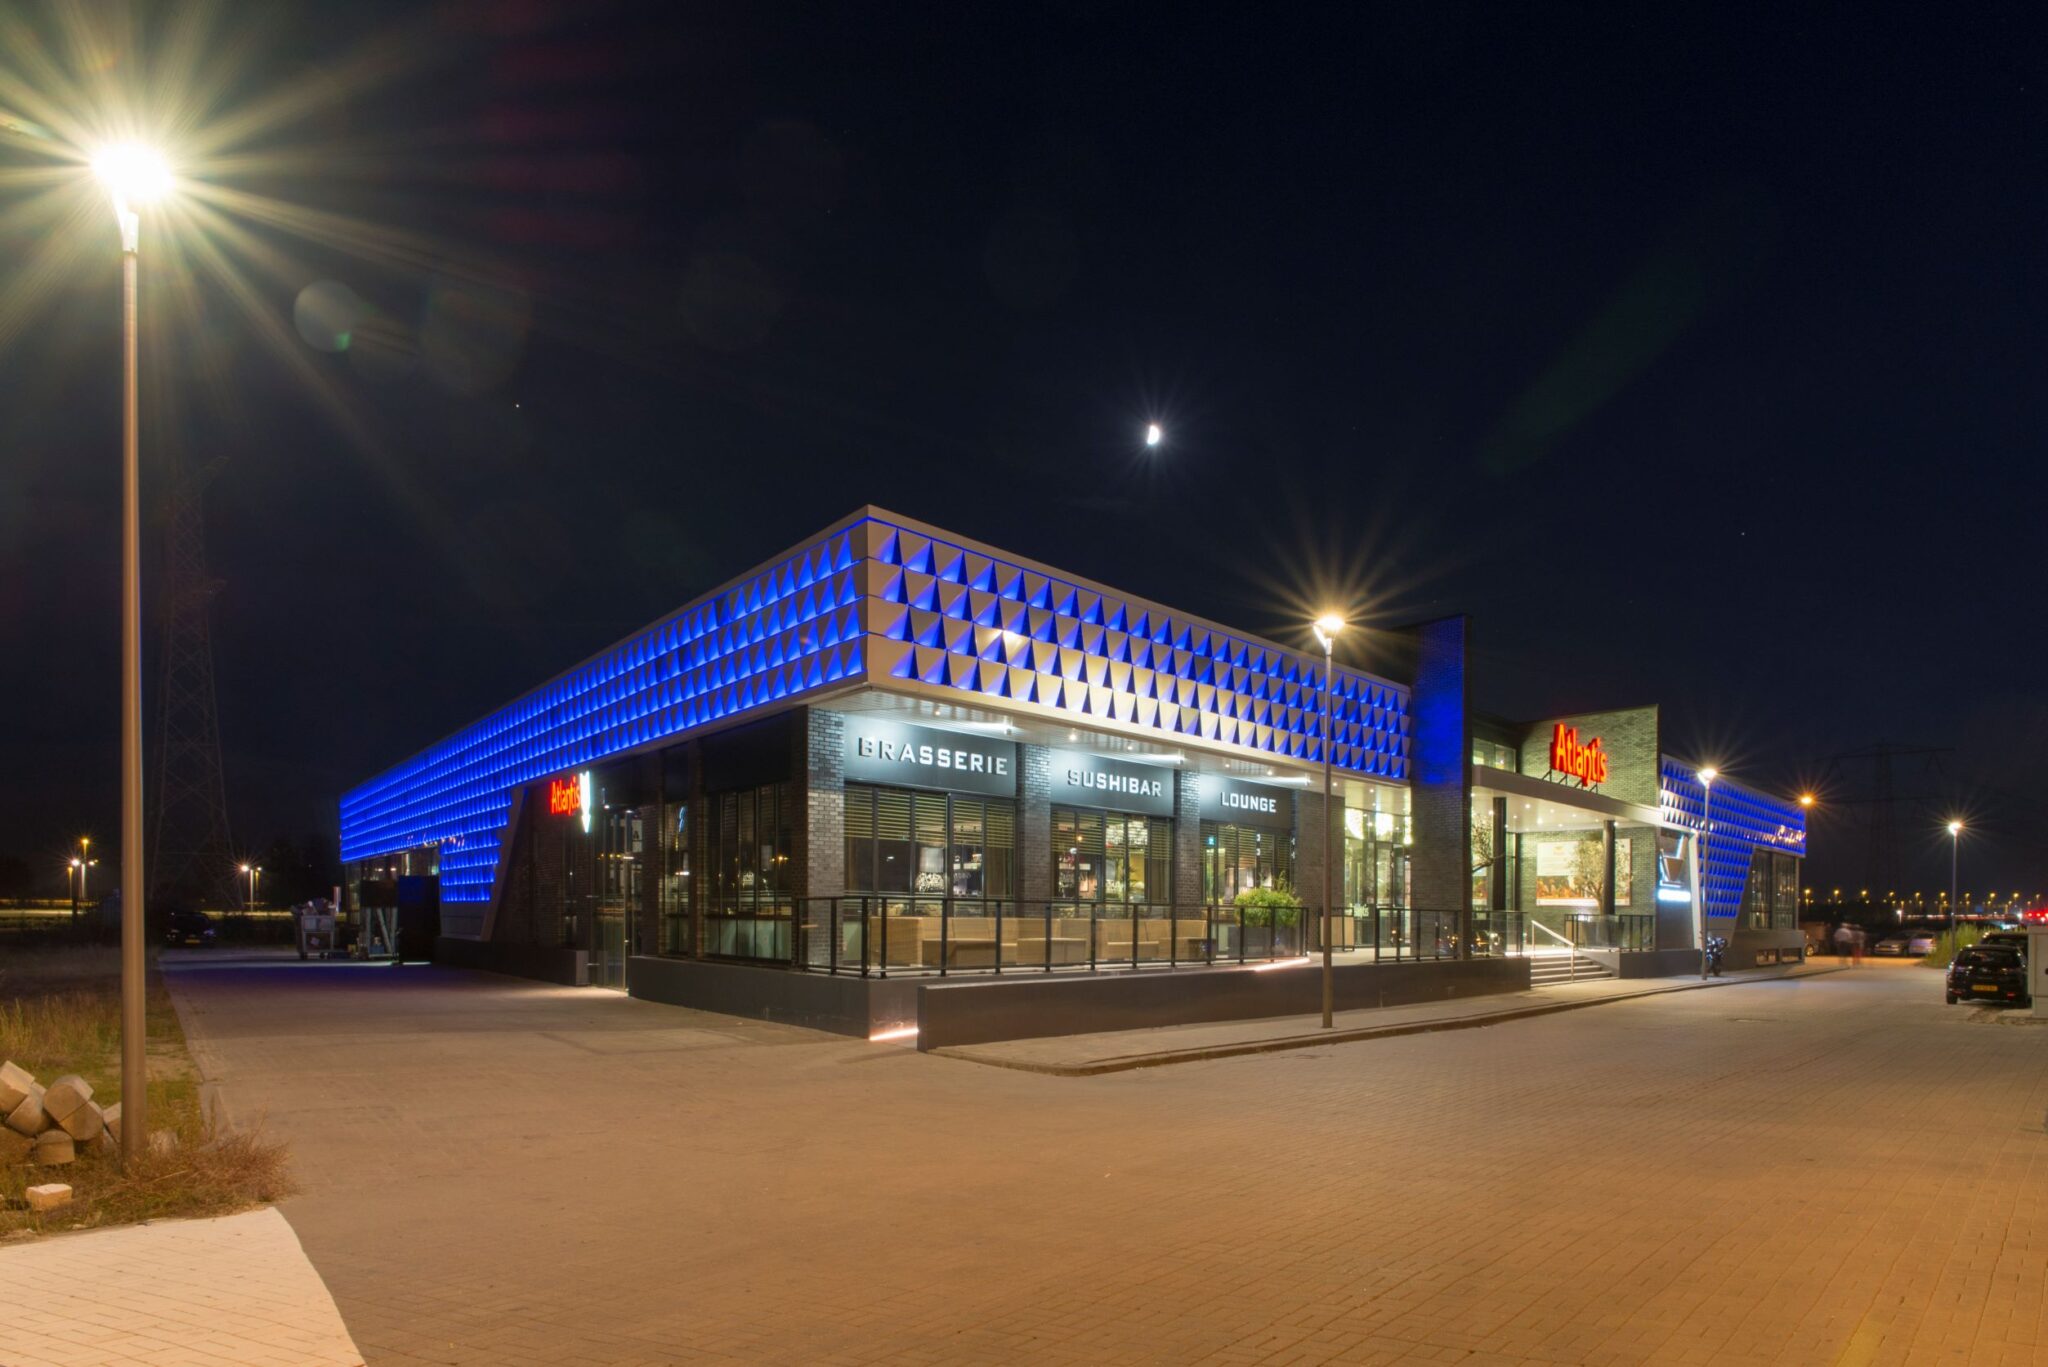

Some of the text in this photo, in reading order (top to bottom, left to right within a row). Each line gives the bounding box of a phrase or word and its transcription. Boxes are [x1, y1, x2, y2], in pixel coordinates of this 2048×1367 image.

[858, 737, 1008, 776] BRASSERIE
[1551, 723, 1607, 787] Atlantis
[551, 775, 580, 816] Atlantis
[1068, 769, 1162, 797] SUSHIBAR
[1221, 791, 1277, 813] LOUNGE
